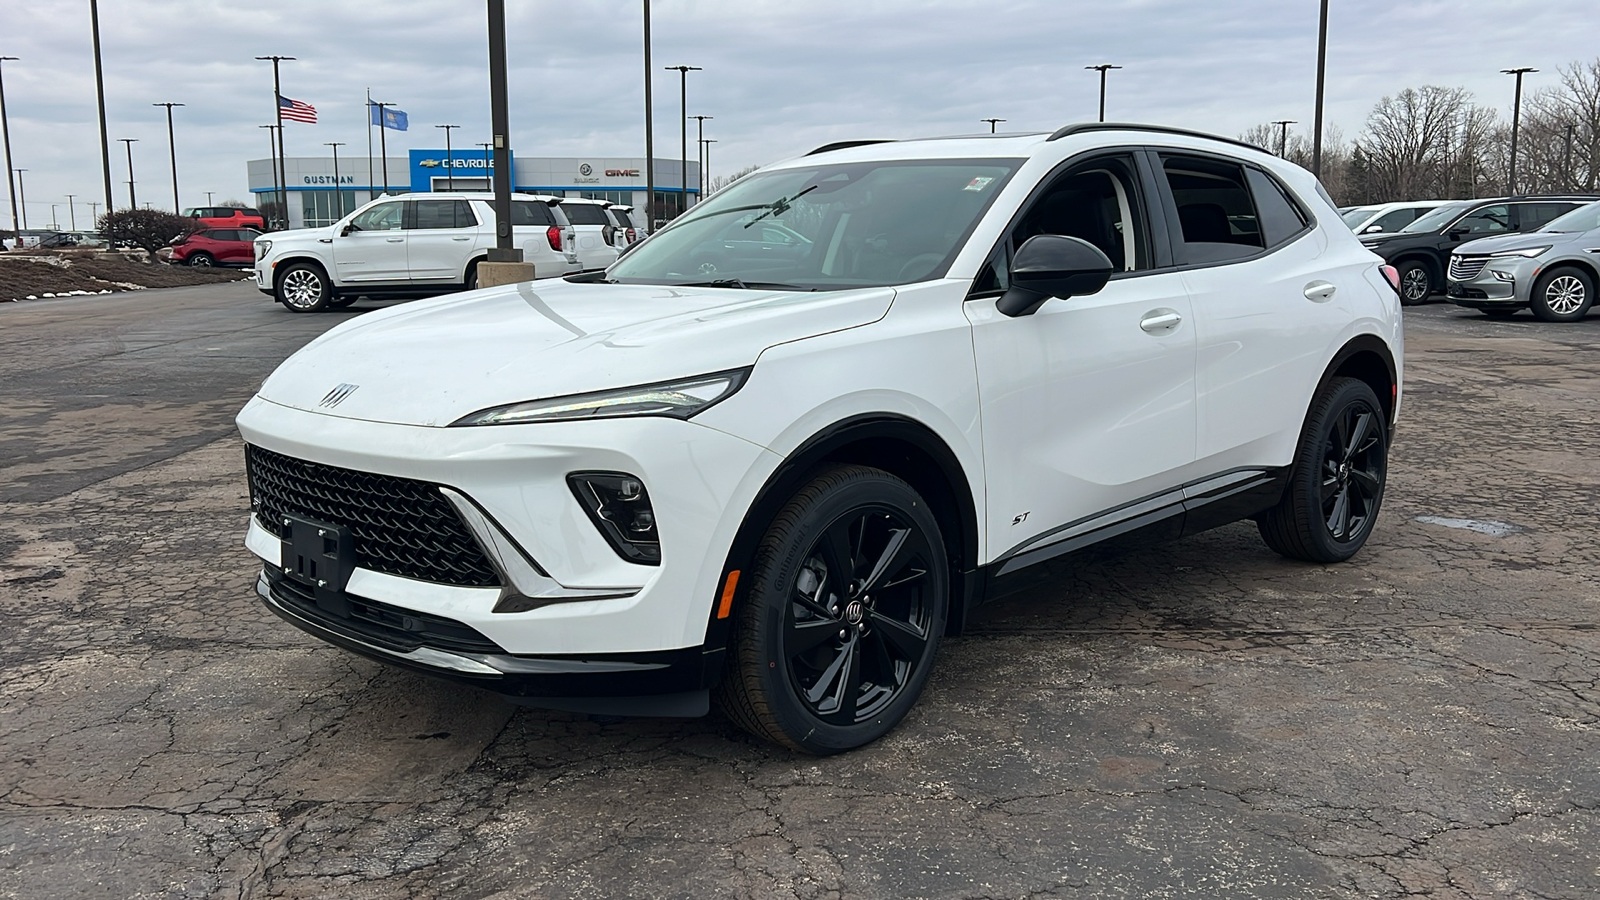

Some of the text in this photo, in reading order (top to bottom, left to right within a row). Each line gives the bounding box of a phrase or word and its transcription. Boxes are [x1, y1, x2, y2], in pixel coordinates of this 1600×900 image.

[442, 159, 495, 168] CHEVROLE
[605, 169, 640, 177] GMC
[303, 175, 354, 184] GUSTMAN
[1011, 510, 1031, 526] ST
